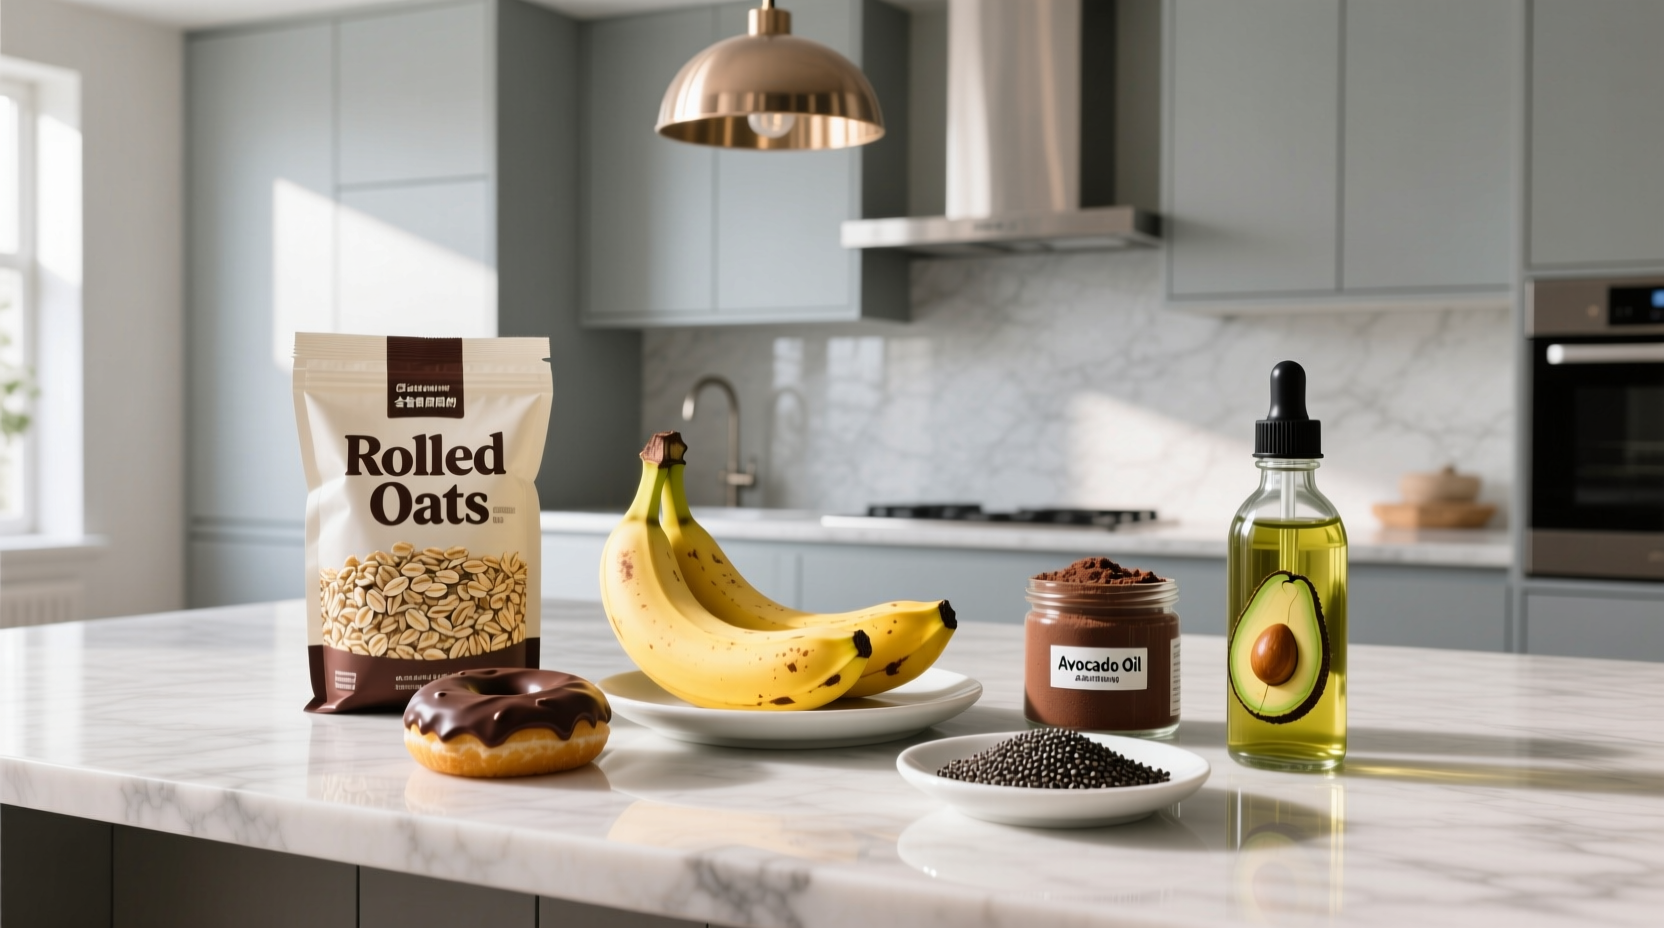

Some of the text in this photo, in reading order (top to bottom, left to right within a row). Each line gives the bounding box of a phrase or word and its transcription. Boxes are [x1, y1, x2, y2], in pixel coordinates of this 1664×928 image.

[345, 432, 506, 476] Rolled
[370, 482, 489, 526] Oats
[1058, 655, 1142, 672] Avocado Oil
